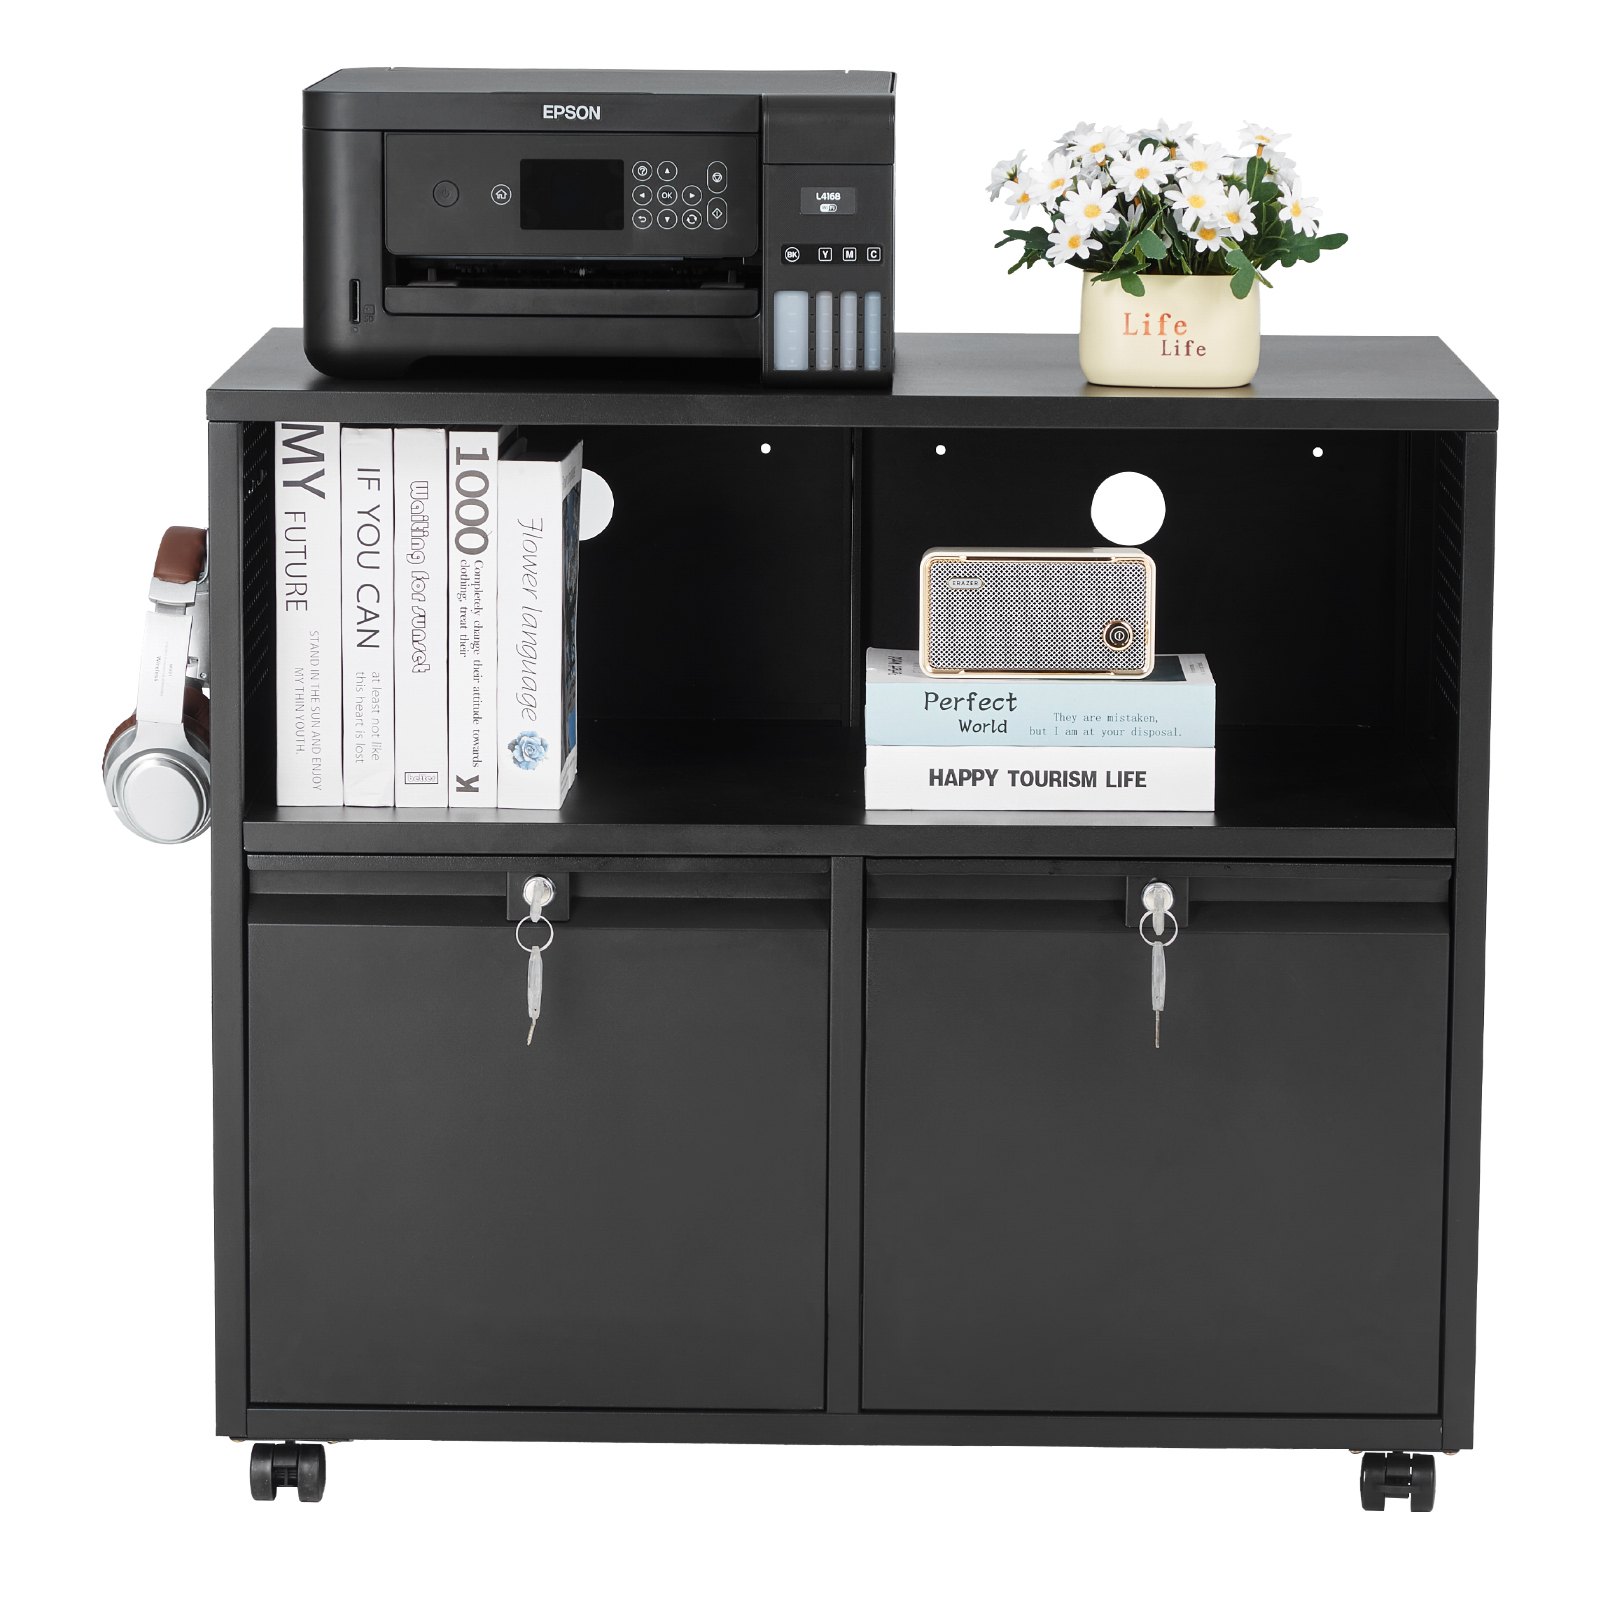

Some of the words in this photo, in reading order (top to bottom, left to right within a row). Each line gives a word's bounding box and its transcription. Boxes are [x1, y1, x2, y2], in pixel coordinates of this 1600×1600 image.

[542, 105, 601, 121] EPSON
[661, 191, 673, 199] OK
[816, 192, 841, 200] L4168
[1123, 313, 1187, 335] Life
[1161, 340, 1206, 356] Life
[281, 423, 325, 499] MY
[357, 468, 380, 491] IF
[455, 447, 489, 555] 1000
[406, 481, 429, 564] Waiting
[357, 504, 380, 569] YOU
[285, 512, 307, 611] FUTURE
[517, 518, 543, 599] Flower
[411, 571, 429, 602] for
[457, 559, 470, 602] clothing,
[471, 560, 484, 616] Completely
[357, 584, 380, 648] CAN
[459, 606, 469, 629] treat
[310, 631, 319, 666] STAND
[412, 606, 430, 673] sunset
[459, 634, 470, 658] their
[471, 620, 484, 655] change
[295, 668, 304, 683] MY
[310, 670, 319, 679] IN
[472, 659, 483, 683] their
[516, 606, 542, 721] language
[356, 672, 366, 692] this
[372, 672, 380, 682] at
[295, 687, 304, 711] THIN
[311, 685, 320, 702] THE
[372, 688, 382, 713] least
[925, 691, 1017, 712] Perfect
[311, 707, 320, 727] SUN
[355, 697, 365, 726] heart
[472, 686, 484, 726] attitude
[1054, 713, 1076, 723] They
[1083, 715, 1102, 723] are
[1107, 713, 1157, 723] mistaken,
[296, 715, 305, 754] YOUTH.
[372, 719, 380, 737] not
[959, 719, 1007, 733] World
[1030, 726, 1046, 735] but
[1082, 728, 1095, 736] at
[1101, 729, 1126, 738] your
[1131, 726, 1181, 737] disposal.
[312, 731, 321, 754] AND
[356, 744, 366, 763] lost
[372, 742, 382, 760] like
[472, 729, 484, 768] towards
[312, 758, 321, 790] ENJOY
[930, 769, 999, 786] HAPPY
[1008, 770, 1096, 787] TOURISM
[1106, 771, 1146, 787] LIFE
